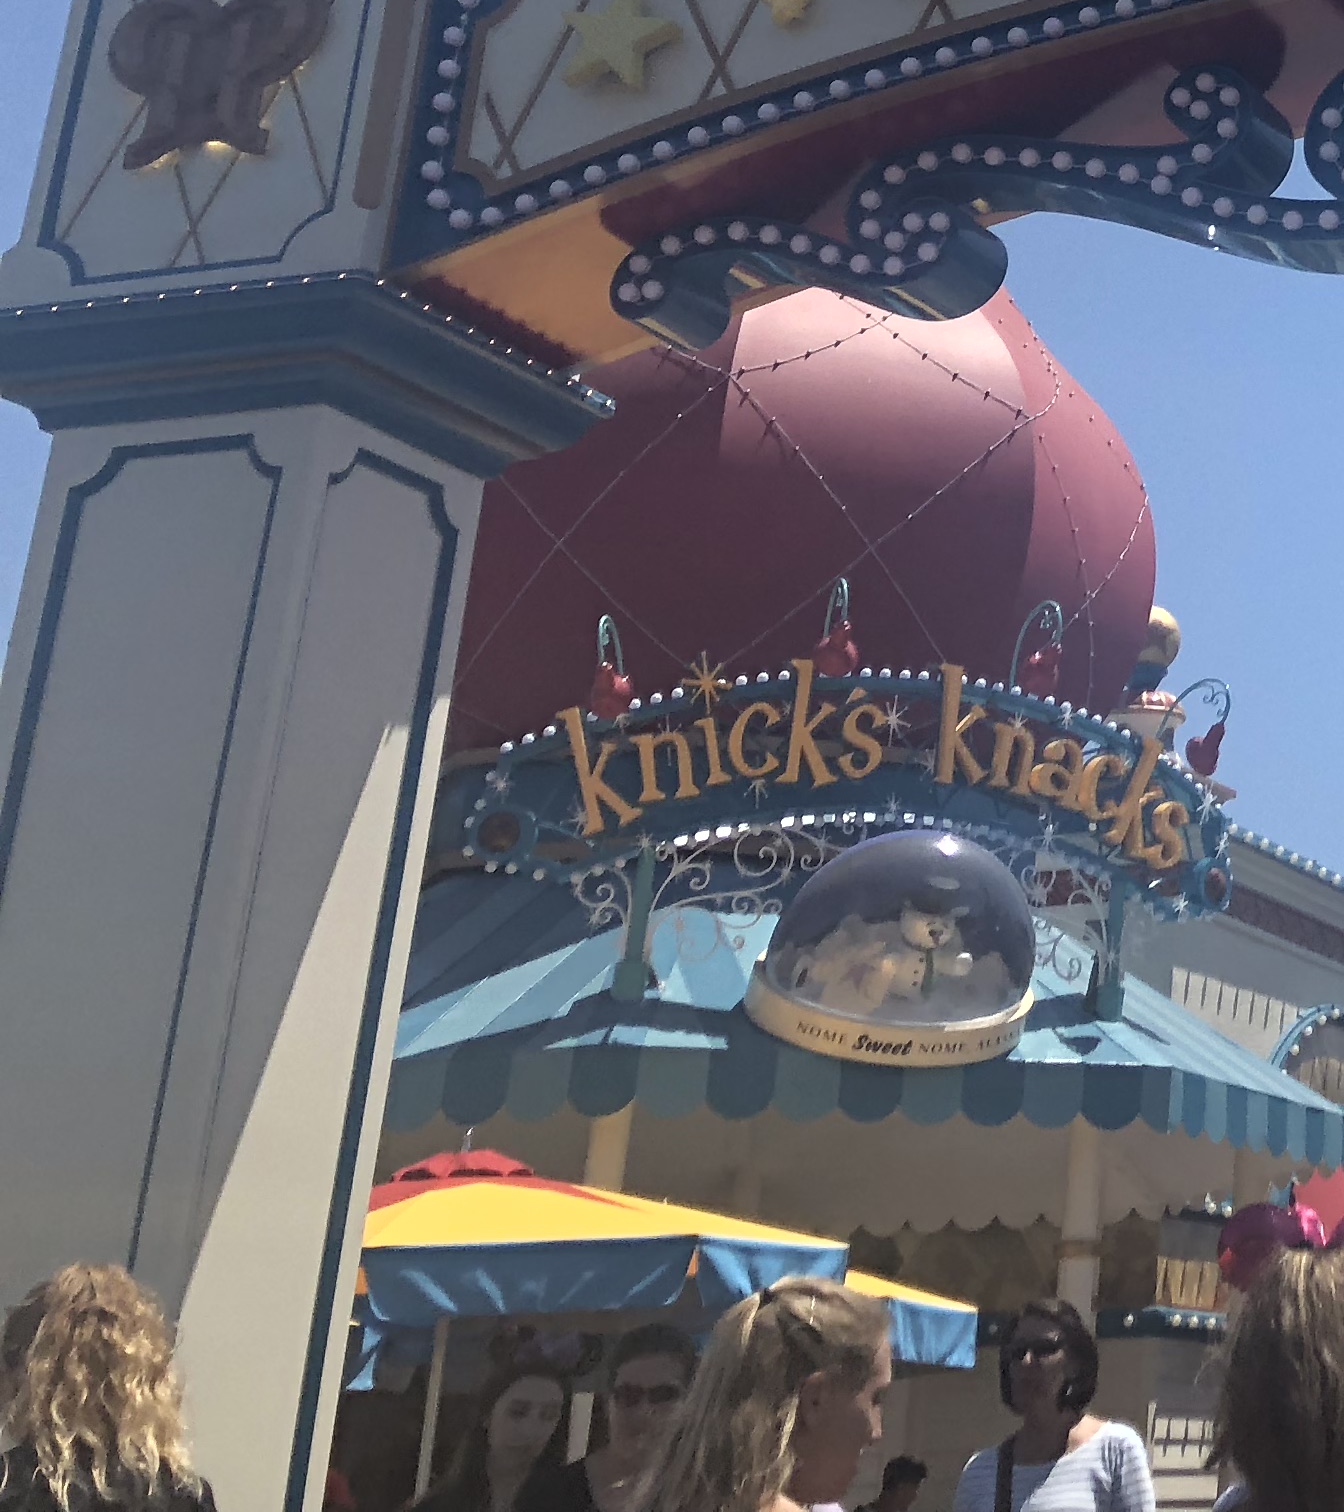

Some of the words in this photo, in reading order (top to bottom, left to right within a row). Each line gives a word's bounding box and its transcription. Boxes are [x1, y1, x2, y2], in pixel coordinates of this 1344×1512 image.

[556, 658, 888, 835] knick's
[934, 662, 1190, 870] knacks
[851, 1033, 913, 1056] Sweet
